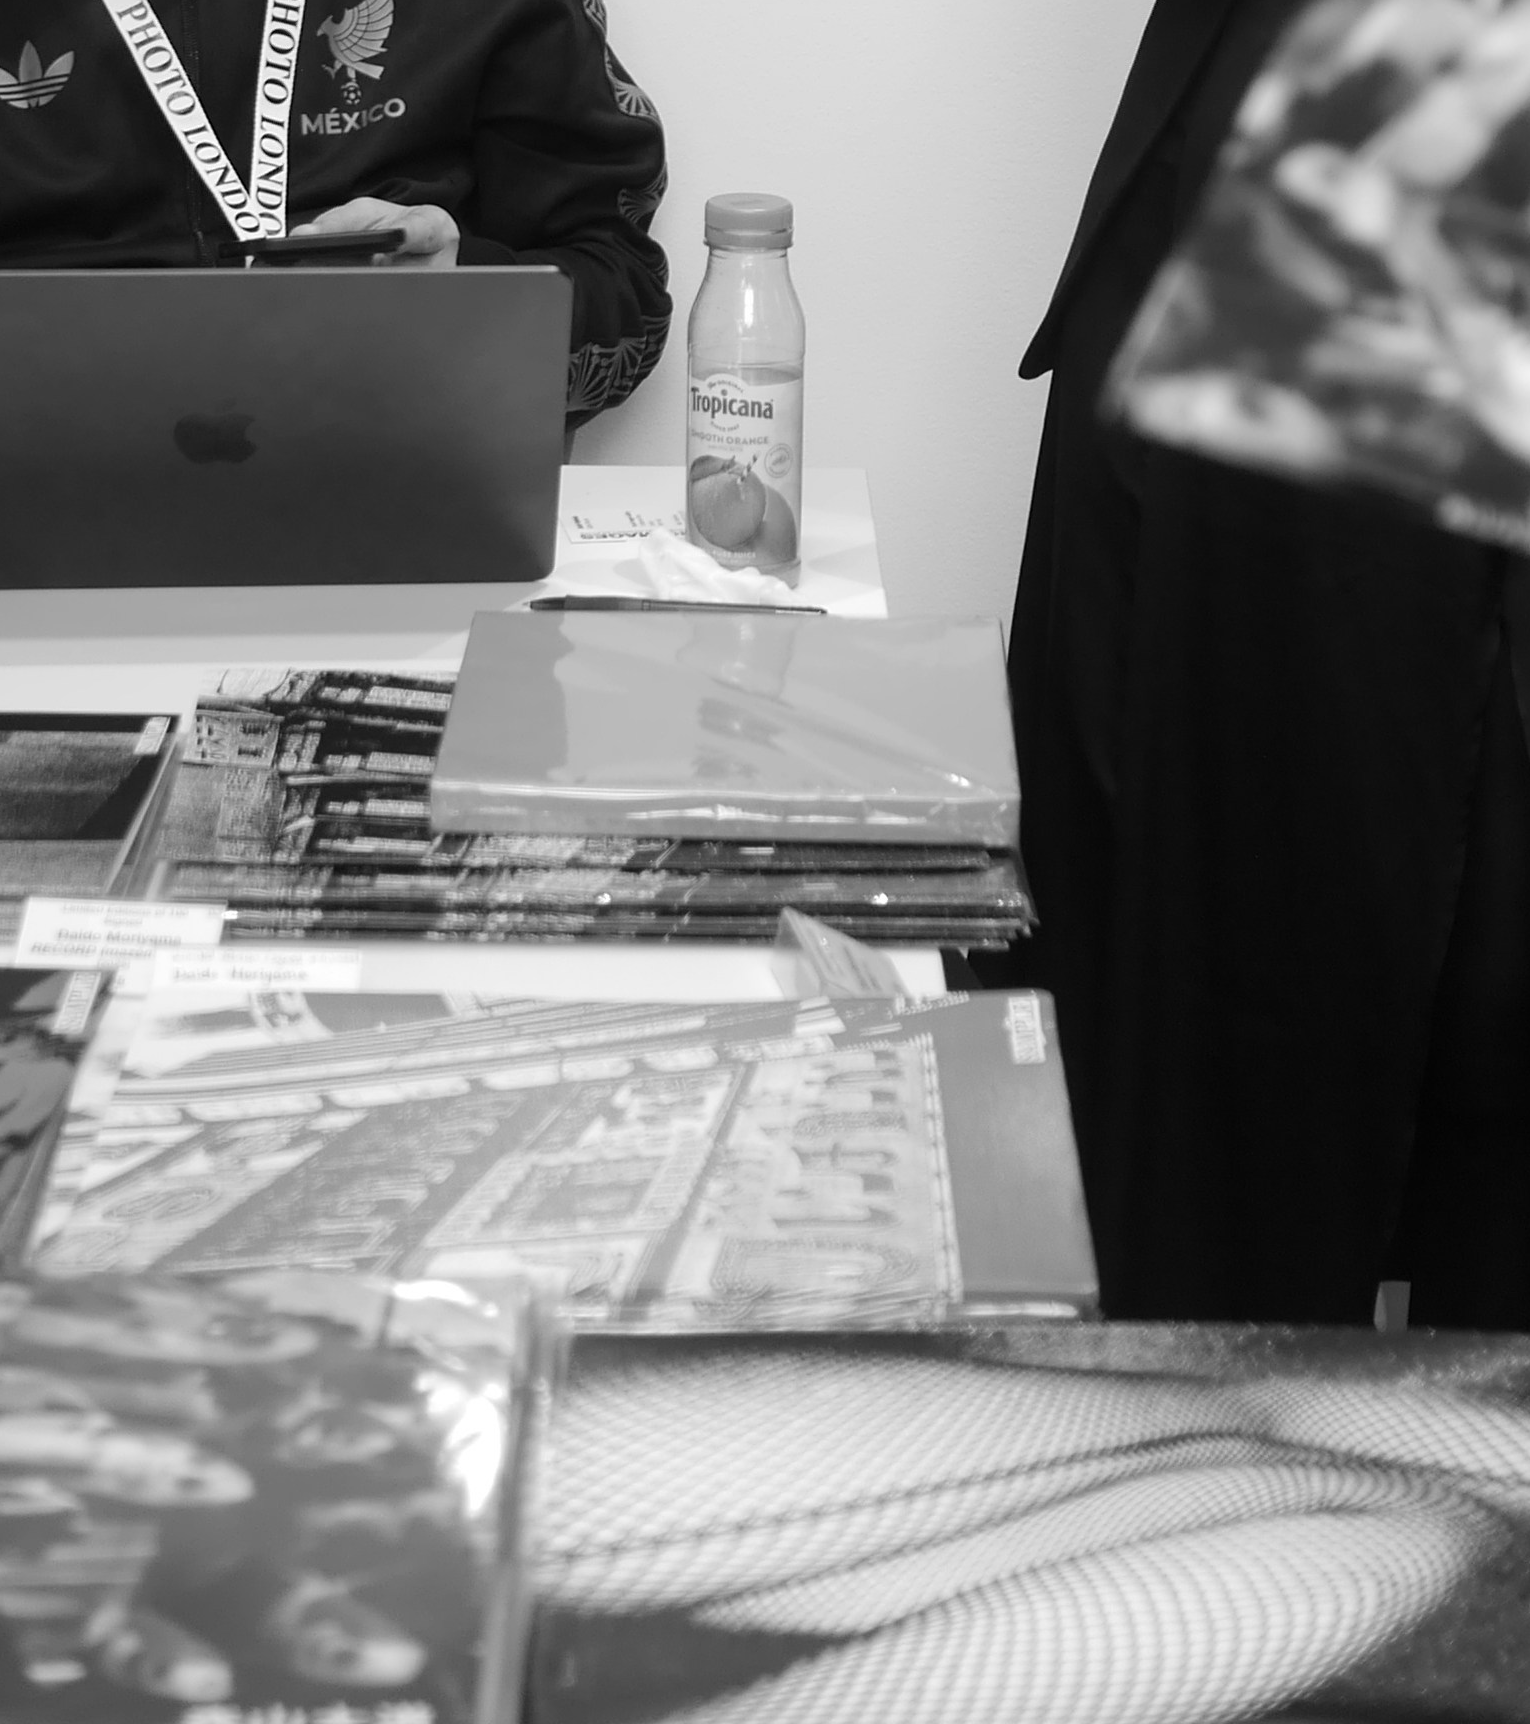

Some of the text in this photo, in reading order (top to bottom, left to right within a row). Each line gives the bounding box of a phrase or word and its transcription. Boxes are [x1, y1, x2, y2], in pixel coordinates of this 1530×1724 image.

[118, 0, 196, 116] PHOTO
[181, 123, 261, 234] LONDO
[300, 97, 407, 135] MÉXICO
[691, 386, 773, 419] Tropicana
[726, 434, 770, 445] ORANGE
